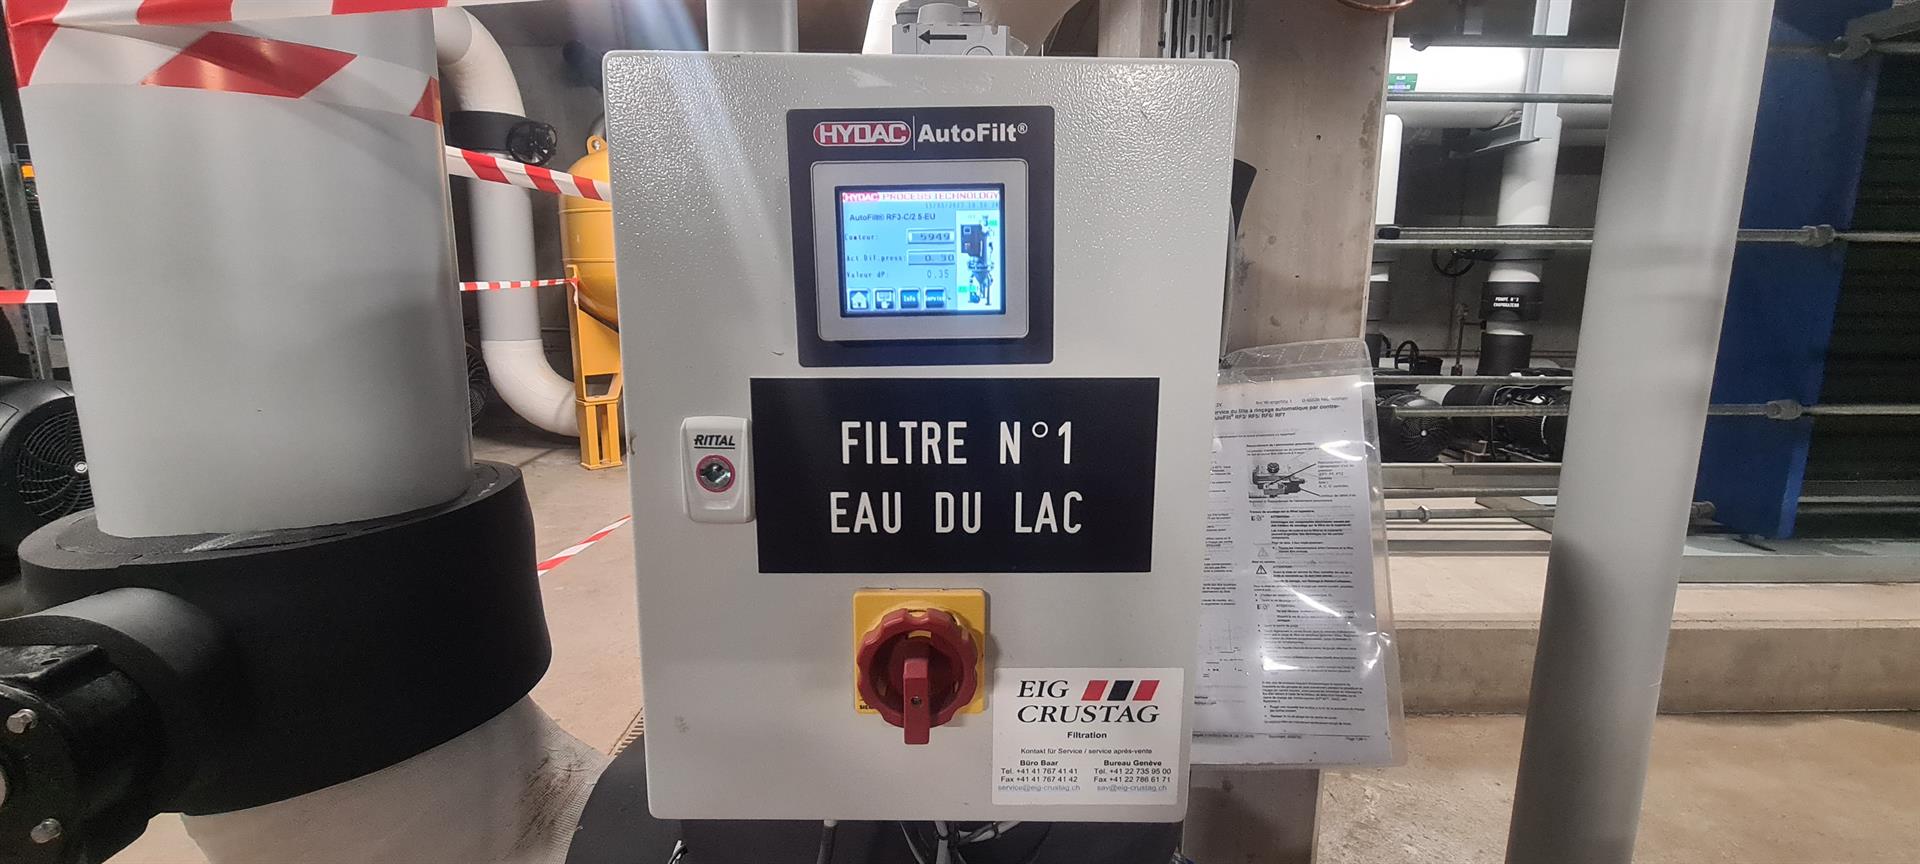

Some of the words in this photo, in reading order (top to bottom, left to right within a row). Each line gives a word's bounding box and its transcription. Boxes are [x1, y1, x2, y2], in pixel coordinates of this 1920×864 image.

[819, 123, 907, 144] HYDAC
[843, 192, 880, 201] HYDAC
[882, 192, 931, 200] PROCESS
[934, 191, 999, 200] TECHNOLOGY
[920, 232, 950, 240] 5949
[846, 270, 872, 278] Valeur
[926, 269, 950, 279] 0.35
[693, 434, 736, 446] RITTAL
[841, 421, 968, 465] FILTRE
[830, 491, 902, 534] EAU
[935, 491, 982, 534] DU
[1014, 491, 1083, 534] LAC
[1017, 680, 1070, 698] EIG
[1017, 704, 1161, 724] CRUSTAG
[1067, 731, 1108, 740] Filtration
[1020, 759, 1039, 767] Büro
[998, 784, 1081, 792] service@eig-crustag.ch
[1097, 784, 1168, 792] sav@eig-crustag.ch
